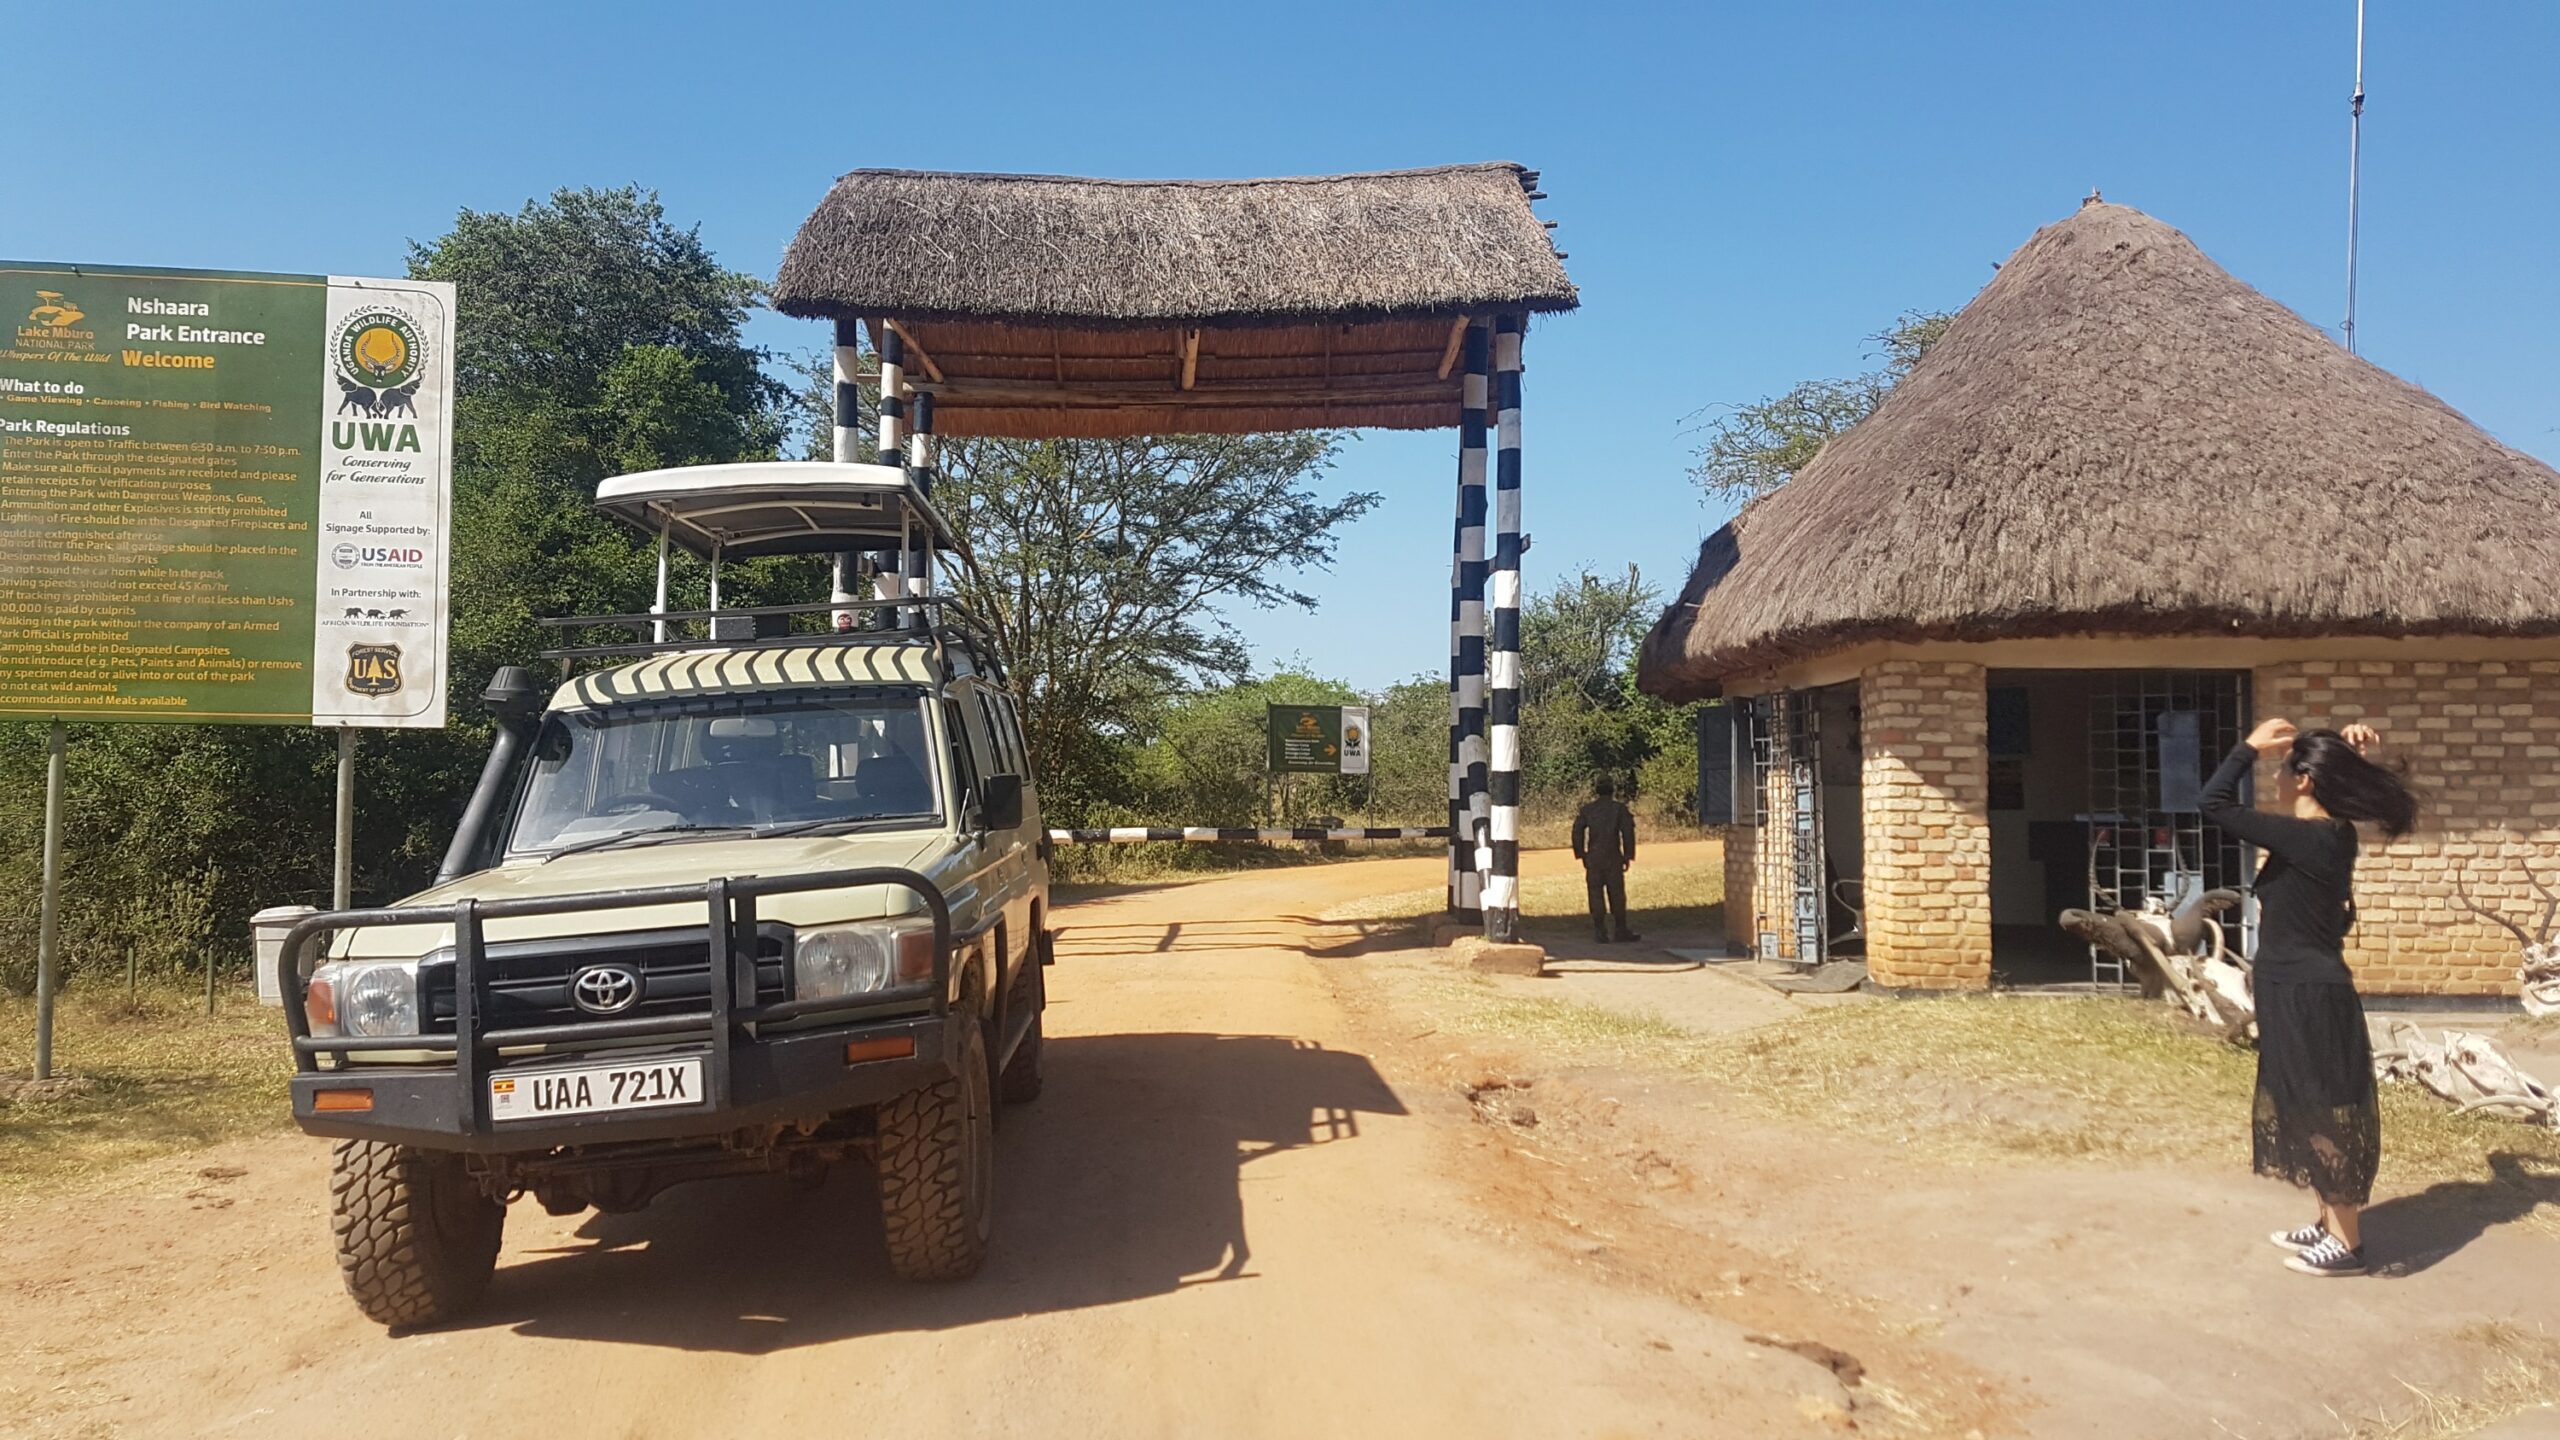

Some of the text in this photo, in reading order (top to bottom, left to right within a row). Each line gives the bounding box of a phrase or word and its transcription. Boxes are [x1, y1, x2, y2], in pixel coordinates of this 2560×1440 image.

[128, 297, 209, 316] Nshaara
[18, 326, 94, 340] Lake Mburo
[126, 324, 265, 344] Park Entrance
[16, 338, 95, 350] NATIONAL PARK
[342, 316, 418, 378] UGANDA WILDLIFE AUTHORITY
[64, 352, 112, 362] The Wild
[122, 350, 214, 368] Welcome
[0, 378, 84, 394] What to do
[6, 394, 272, 412] Game Viewing Canoeing Fishing Bird Watching
[0, 418, 130, 436] Park Regulations
[26, 437, 252, 453] Park open Traffic between to
[332, 422, 422, 453] UWA
[3, 449, 237, 466] Enter the Park through the designated gates
[342, 456, 412, 472] Conserving
[3, 462, 31, 472] Make
[34, 464, 58, 472] sure
[60, 464, 72, 473] all
[76, 464, 111, 474] official
[114, 467, 166, 476] payments
[188, 468, 238, 479] receipted
[240, 471, 260, 480] and
[262, 471, 297, 481] please
[326, 470, 426, 485] for Generations
[2, 475, 212, 490] retain receipts for Verification purposes
[2, 486, 47, 499] Entering
[50, 488, 68, 498] the
[70, 489, 94, 498] Park
[97, 490, 120, 499] with
[122, 490, 179, 502] Dangerous
[236, 494, 266, 504] Guns,
[1, 500, 288, 517] Ammunition and other Explosives strictly prohibited
[359, 511, 372, 520] All
[1, 512, 308, 531] Lighting Fire should Designated Fireplaces and
[44, 530, 114, 542] extinguished
[326, 523, 430, 536] Signage Supported by:
[66, 540, 84, 550] the
[132, 543, 174, 554] garbage
[177, 544, 212, 552] should
[215, 544, 228, 553] be
[230, 544, 266, 554] placed
[280, 546, 297, 555] the
[362, 548, 423, 562] USAID
[63, 552, 106, 562] Rubbish
[36, 566, 70, 574] sound
[112, 568, 136, 576] horn
[138, 568, 167, 577] while
[40, 580, 78, 588] speeds
[80, 580, 116, 590] should
[118, 581, 136, 590] not
[139, 580, 176, 590] exceed
[16, 590, 60, 602] tracking
[74, 592, 128, 603] prohibited
[131, 594, 151, 602] and
[218, 595, 240, 605] less
[242, 596, 266, 606] than
[331, 588, 422, 600] In Partnership with:
[56, 604, 136, 616] paid by culprits
[54, 617, 71, 627] the
[73, 618, 98, 628] park
[100, 619, 140, 628] without
[164, 621, 212, 631] company
[244, 621, 280, 631] Armed
[22, 629, 128, 641] Official prohibited
[45, 643, 230, 656] should be Designated Campsites
[11, 656, 302, 670] not introduce Pets, Paints and Animals) remove
[15, 668, 255, 682] specimen dead alive into out the park
[10, 682, 118, 692] not eat wild animals
[83, 695, 188, 706] and Meals available
[533, 1066, 686, 1110] UAA 721X
